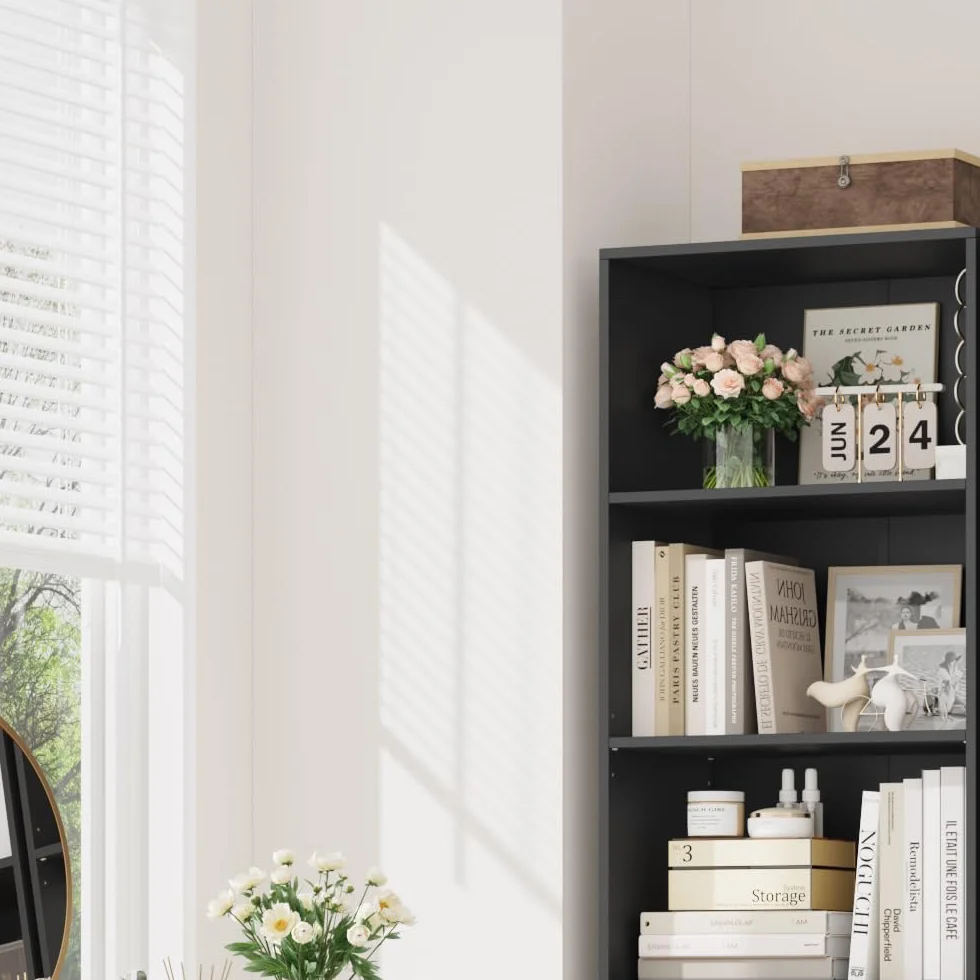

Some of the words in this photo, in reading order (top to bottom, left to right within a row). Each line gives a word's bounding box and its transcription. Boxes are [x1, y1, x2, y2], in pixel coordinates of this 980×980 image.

[812, 329, 835, 337] THE
[839, 326, 881, 335] SECRET
[886, 324, 931, 333] GARDEN
[830, 422, 847, 461] JUN
[869, 424, 891, 454] 2
[909, 419, 932, 450] 4
[730, 556, 738, 581] FRIDA
[672, 576, 680, 609] CLUB
[730, 583, 738, 613] KAHLO
[637, 606, 649, 670] GATHER
[672, 616, 680, 662] PASTRY
[672, 666, 680, 704] PARIS
[945, 820, 957, 829] IL
[682, 844, 693, 862] 3
[853, 829, 876, 935] NOGUCHI
[910, 842, 921, 912] Remodelista
[945, 859, 957, 878] UNE
[751, 888, 806, 905] Storage
[945, 880, 957, 901] FOIS
[893, 908, 902, 933] David
[945, 903, 957, 914] LE
[882, 908, 892, 962] Chipperfield
